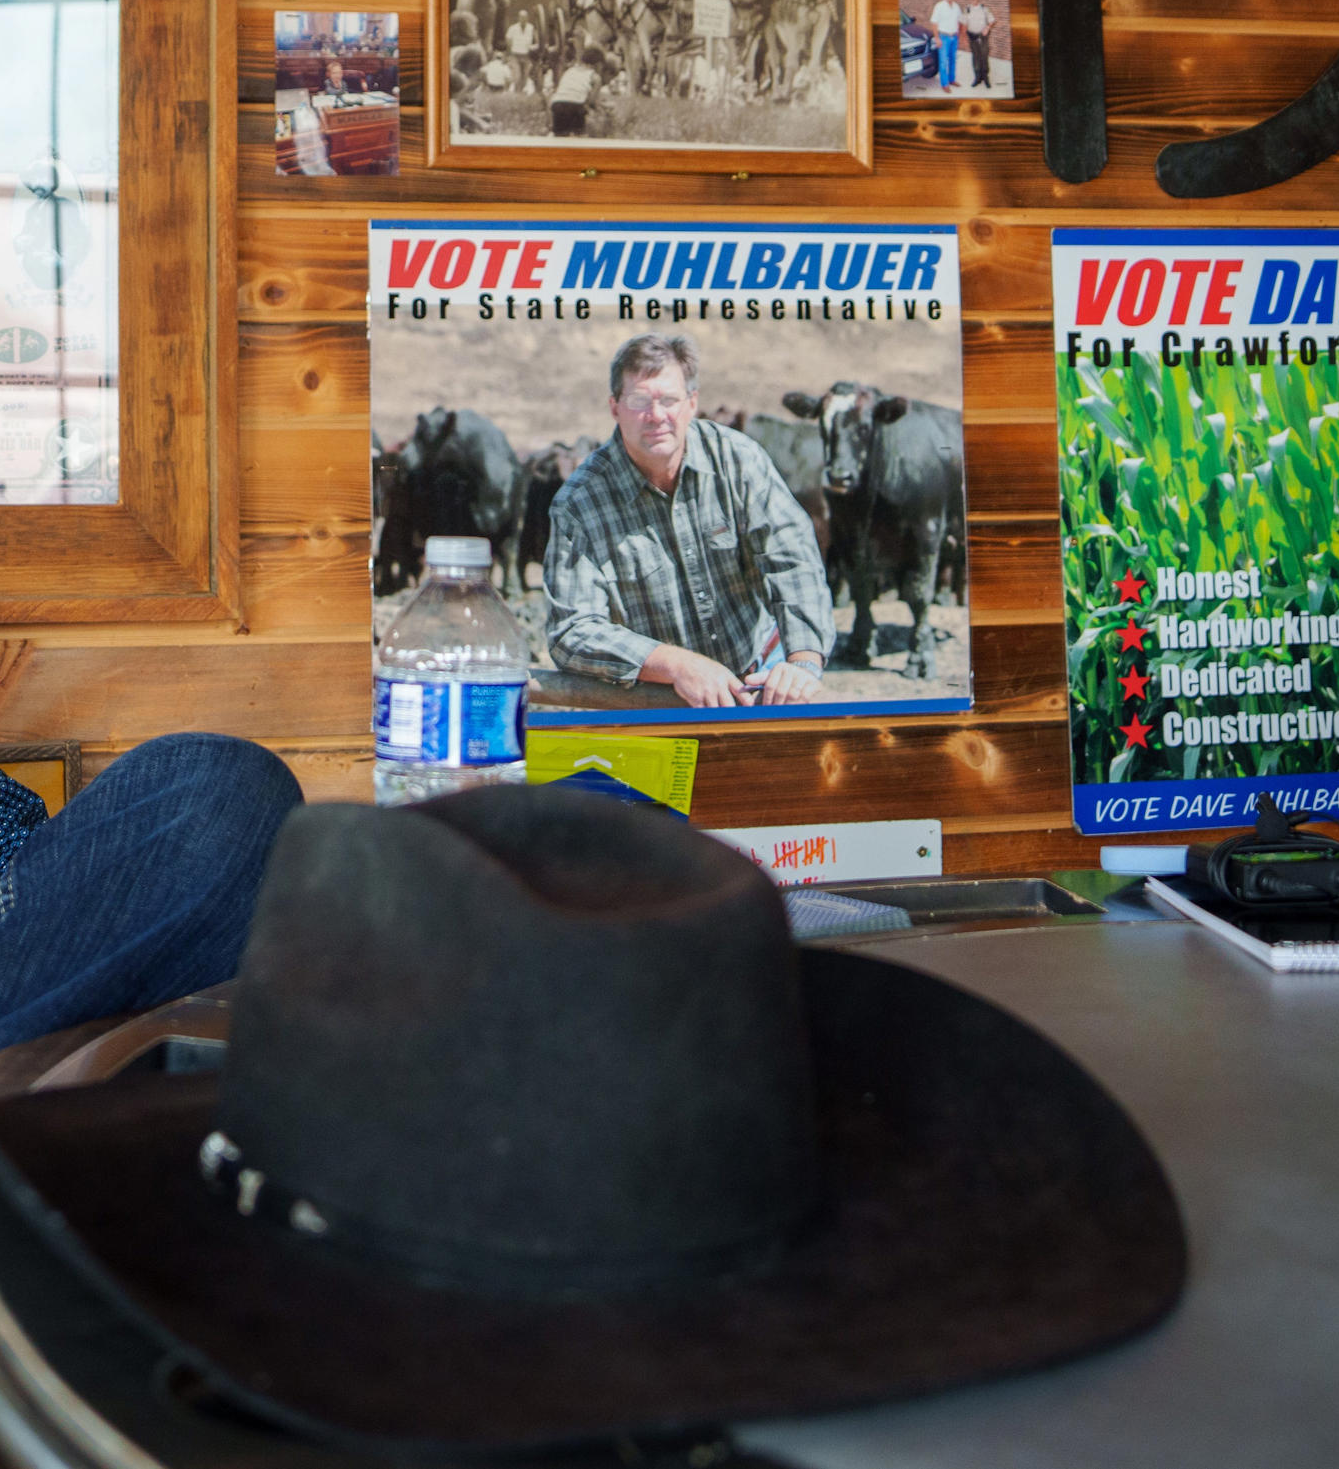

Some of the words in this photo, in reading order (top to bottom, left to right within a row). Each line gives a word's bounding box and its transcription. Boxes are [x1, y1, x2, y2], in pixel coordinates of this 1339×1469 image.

[386, 238, 554, 291] VOTE
[560, 239, 943, 292] MUHLBAUER
[387, 292, 451, 321] For
[478, 292, 591, 322] State
[618, 293, 944, 324] Representative
[1073, 257, 1244, 328] VOTE
[1066, 329, 1135, 368] For
[1156, 565, 1261, 603] Honest
[1161, 658, 1312, 699] Dedicated
[1095, 796, 1162, 823] VOTE
[1169, 792, 1236, 820] DAVE
